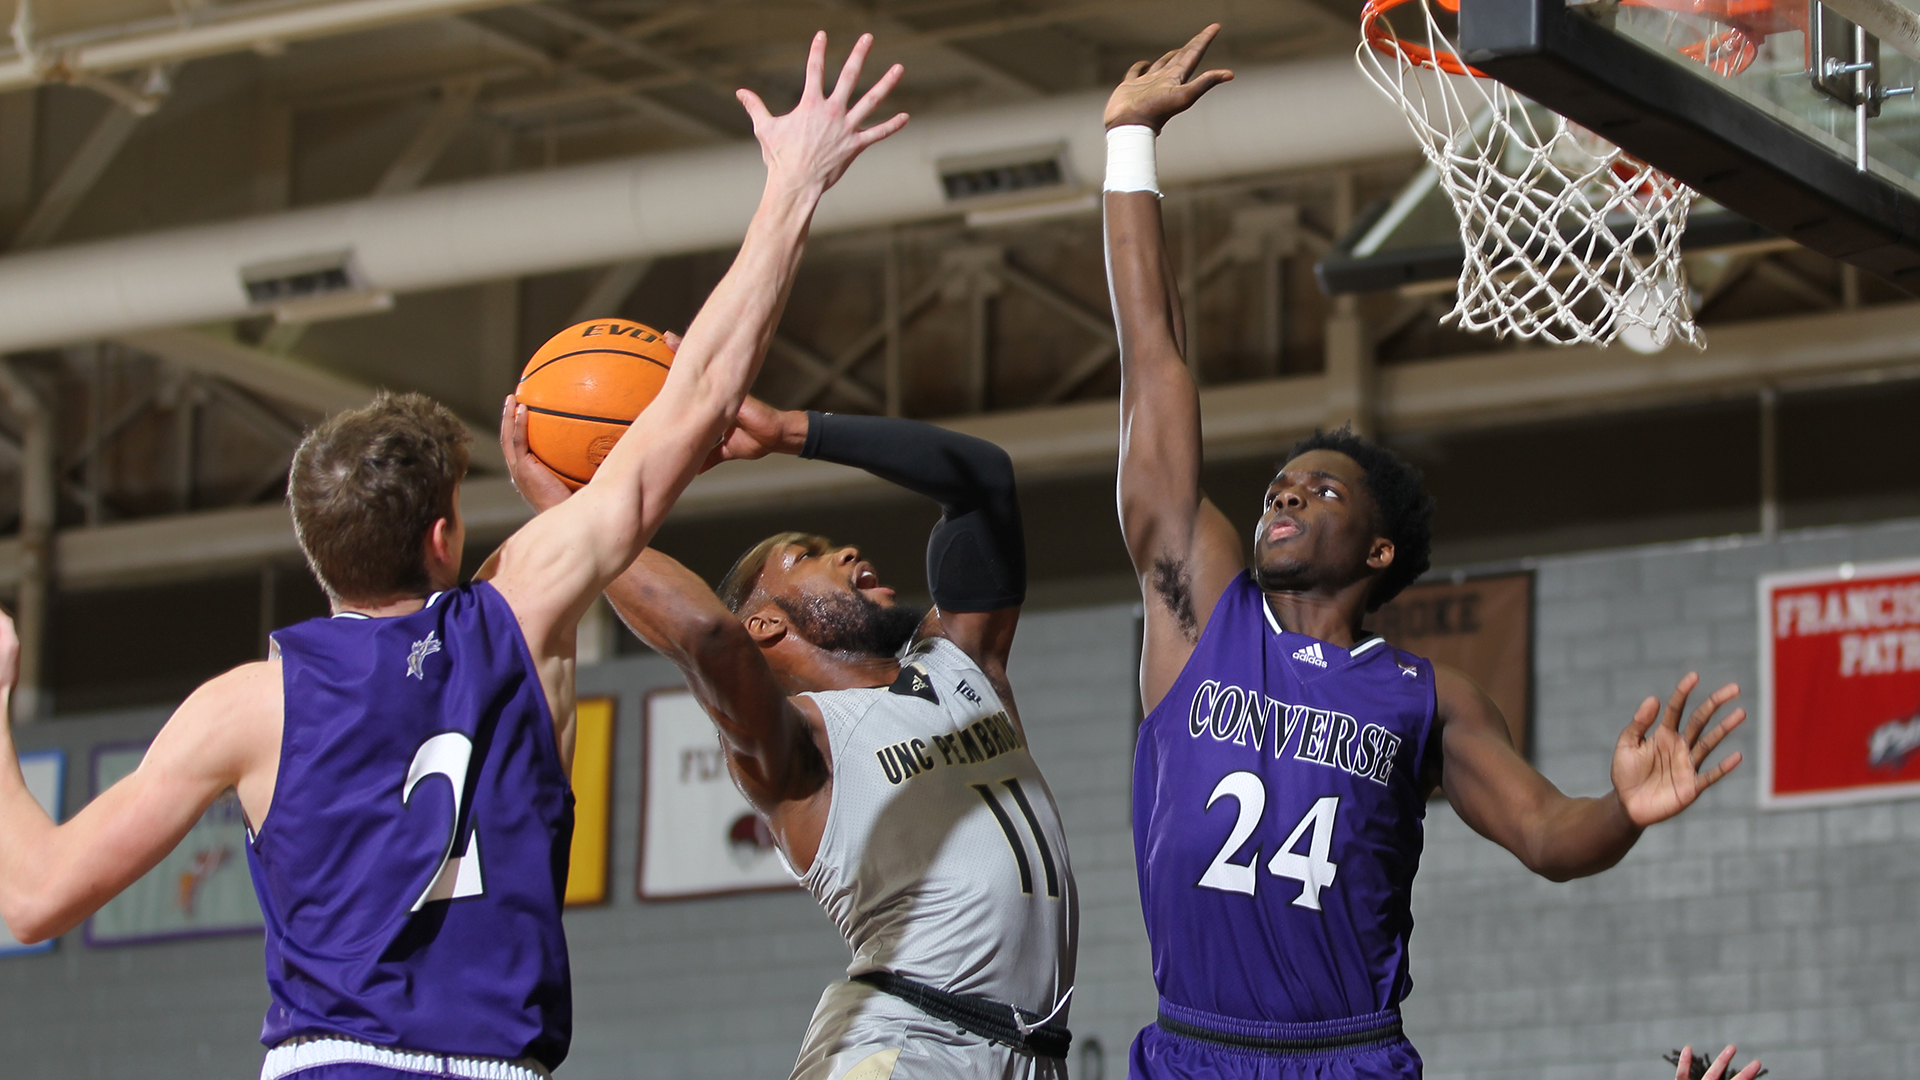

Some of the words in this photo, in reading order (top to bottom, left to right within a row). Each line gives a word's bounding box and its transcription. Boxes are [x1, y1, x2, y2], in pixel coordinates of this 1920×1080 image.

[1292, 650, 1328, 668] adidas
[875, 737, 935, 786] UNC
[1188, 679, 1402, 786] CONVERSE
[403, 730, 484, 912] 2
[967, 776, 1060, 897] 11
[1195, 768, 1341, 912] 24
